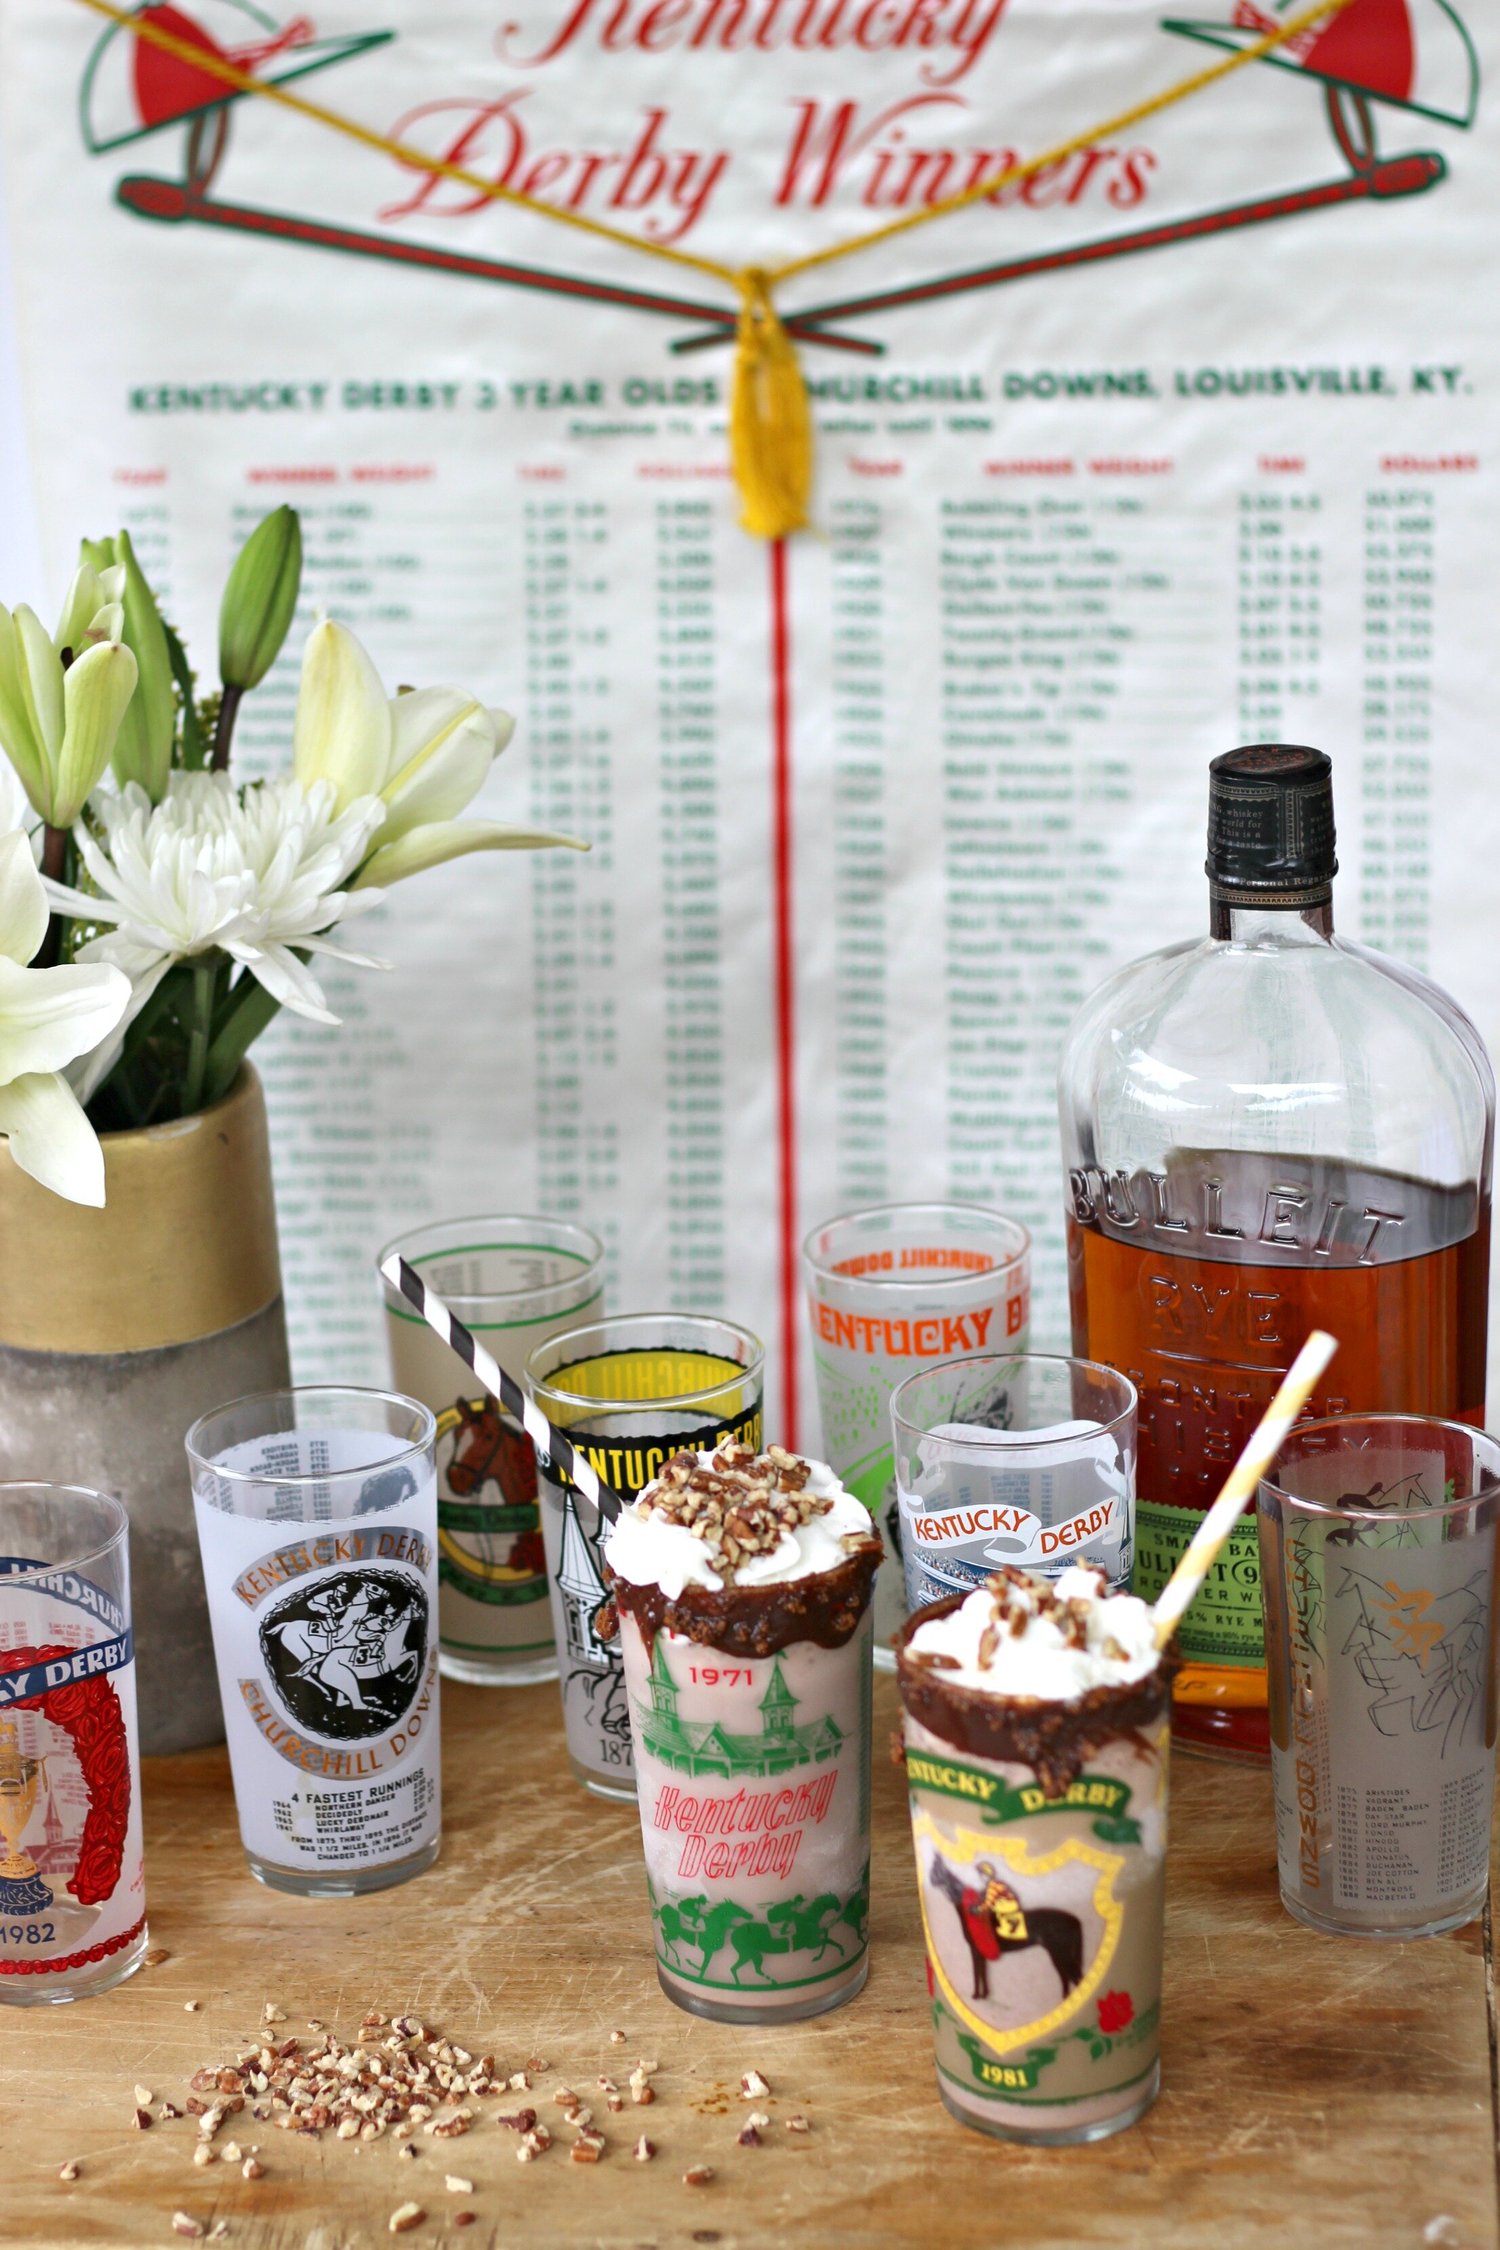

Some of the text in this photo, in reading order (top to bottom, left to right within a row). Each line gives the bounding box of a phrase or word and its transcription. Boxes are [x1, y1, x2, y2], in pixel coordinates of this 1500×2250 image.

[378, 90, 1158, 246] Derby Winners
[128, 380, 327, 414] KENTUCKY
[343, 380, 460, 412] DERBY
[511, 378, 602, 408] YEAR
[622, 375, 720, 405] OLDS
[803, 372, 986, 402] HURCHILL
[1411, 364, 1475, 394] KY.
[1069, 1166, 1406, 1266] BULLEIT
[1150, 1276, 1284, 1346] RYE
[914, 1509, 1033, 1541] KENTUCKY
[1041, 1500, 1114, 1555] DERBY
[236, 1534, 364, 1606] KENTUCKY
[310, 1623, 320, 1634] 2
[1215, 1614, 1245, 1627] RYE
[45, 1637, 127, 1687] DERBY
[356, 1649, 367, 1664] 3
[689, 1665, 754, 1687] 1971
[240, 1649, 438, 1775] CHURCHILL DOWNS
[600, 1739, 633, 1767] 187
[291, 1793, 299, 1803] 4
[306, 1790, 363, 1804] FASTEST
[369, 1768, 424, 1798] RUNNINGS
[906, 1756, 1124, 1813] NTUCKY DRBY
[315, 1801, 362, 1811] NORTHERN
[365, 1793, 396, 1806] DANCER
[315, 1809, 363, 1819] DECIDEDLY
[316, 1817, 343, 1826] LUCKY
[347, 1810, 389, 1825] DEBONAIR
[654, 1769, 839, 1835] Kentucky
[291, 1835, 313, 1844] FROM
[339, 1835, 362, 1844] THRU
[316, 1824, 365, 1834] WHIRLAWAY
[1296, 1759, 1322, 1890] DOWNS
[317, 1852, 355, 1861] CHANGED
[358, 1850, 369, 1858] TO
[677, 1830, 803, 1881] Derby
[0, 1922, 56, 1945] 1982
[981, 2062, 1029, 2088] 1981
